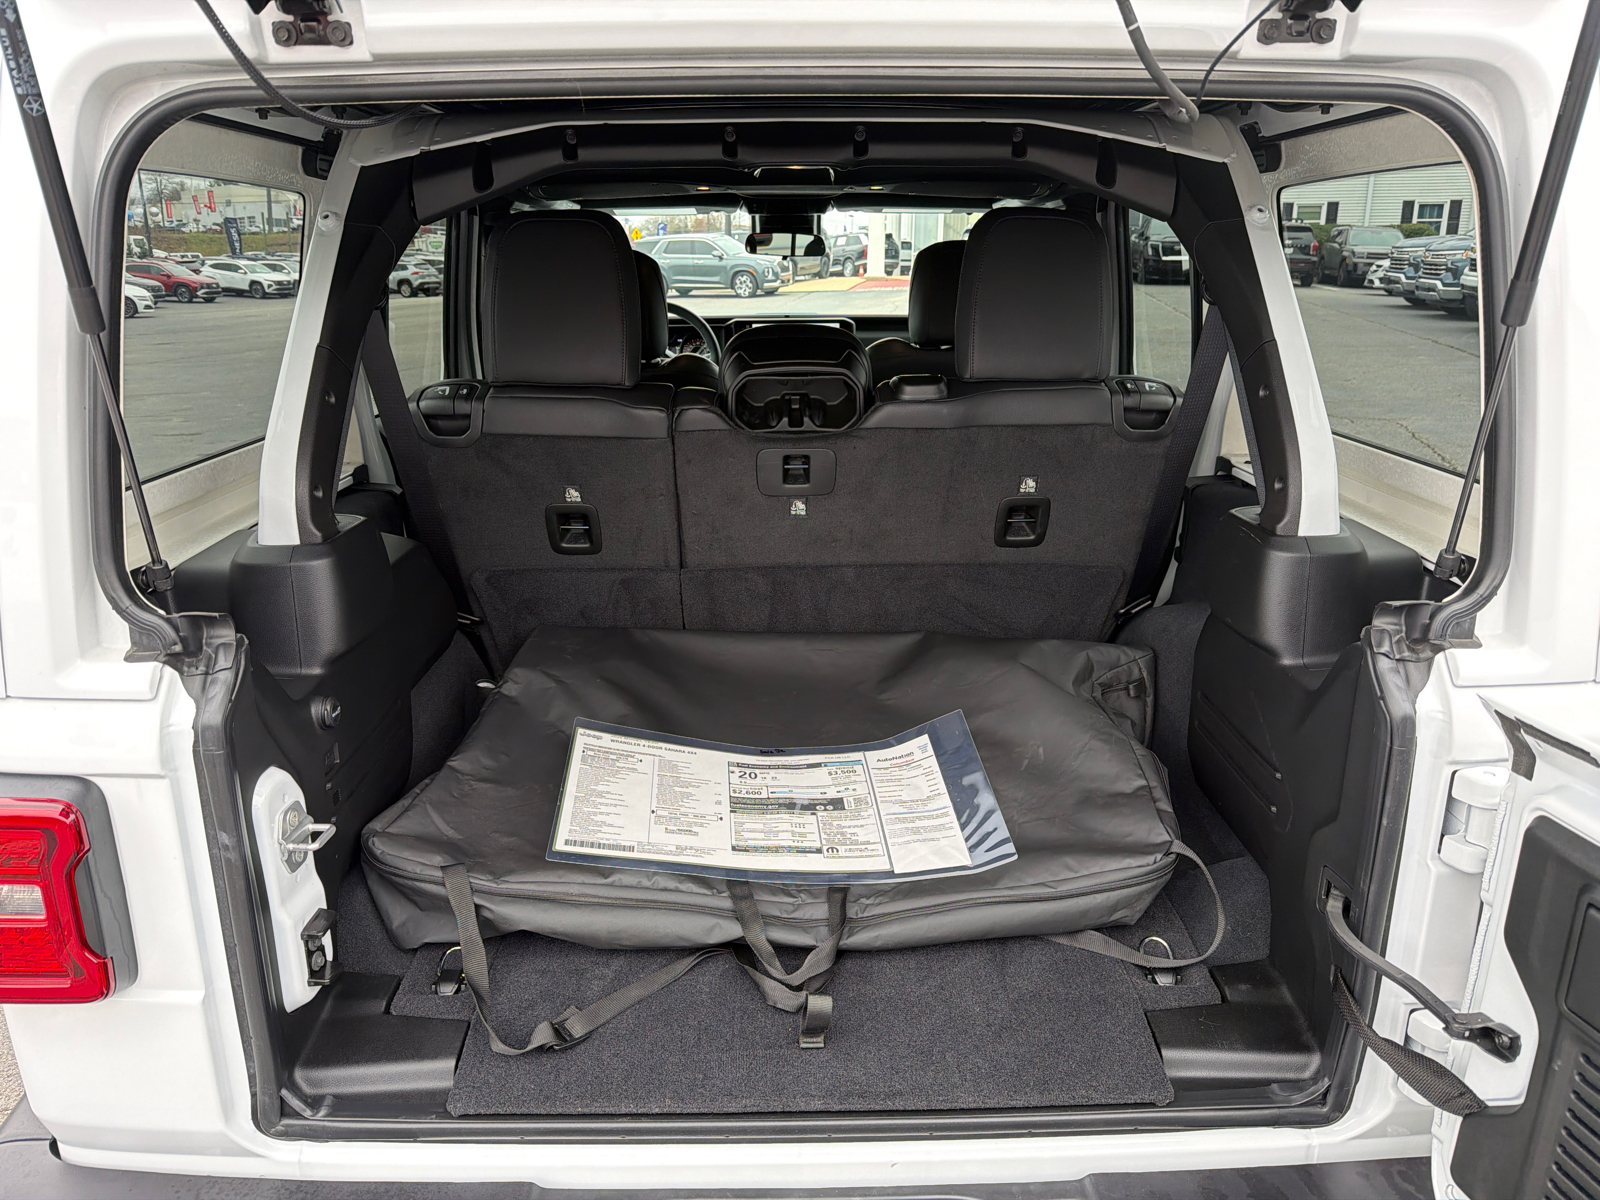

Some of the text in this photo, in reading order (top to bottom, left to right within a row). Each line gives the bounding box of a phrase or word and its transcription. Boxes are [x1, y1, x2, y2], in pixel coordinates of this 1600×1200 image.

[579, 731, 603, 740] Jeep
[610, 738, 641, 747] WRANGLER
[664, 746, 686, 754] SAHARA
[876, 751, 915, 763] AutoNation
[738, 770, 758, 780] 20
[828, 769, 857, 777] $3,500
